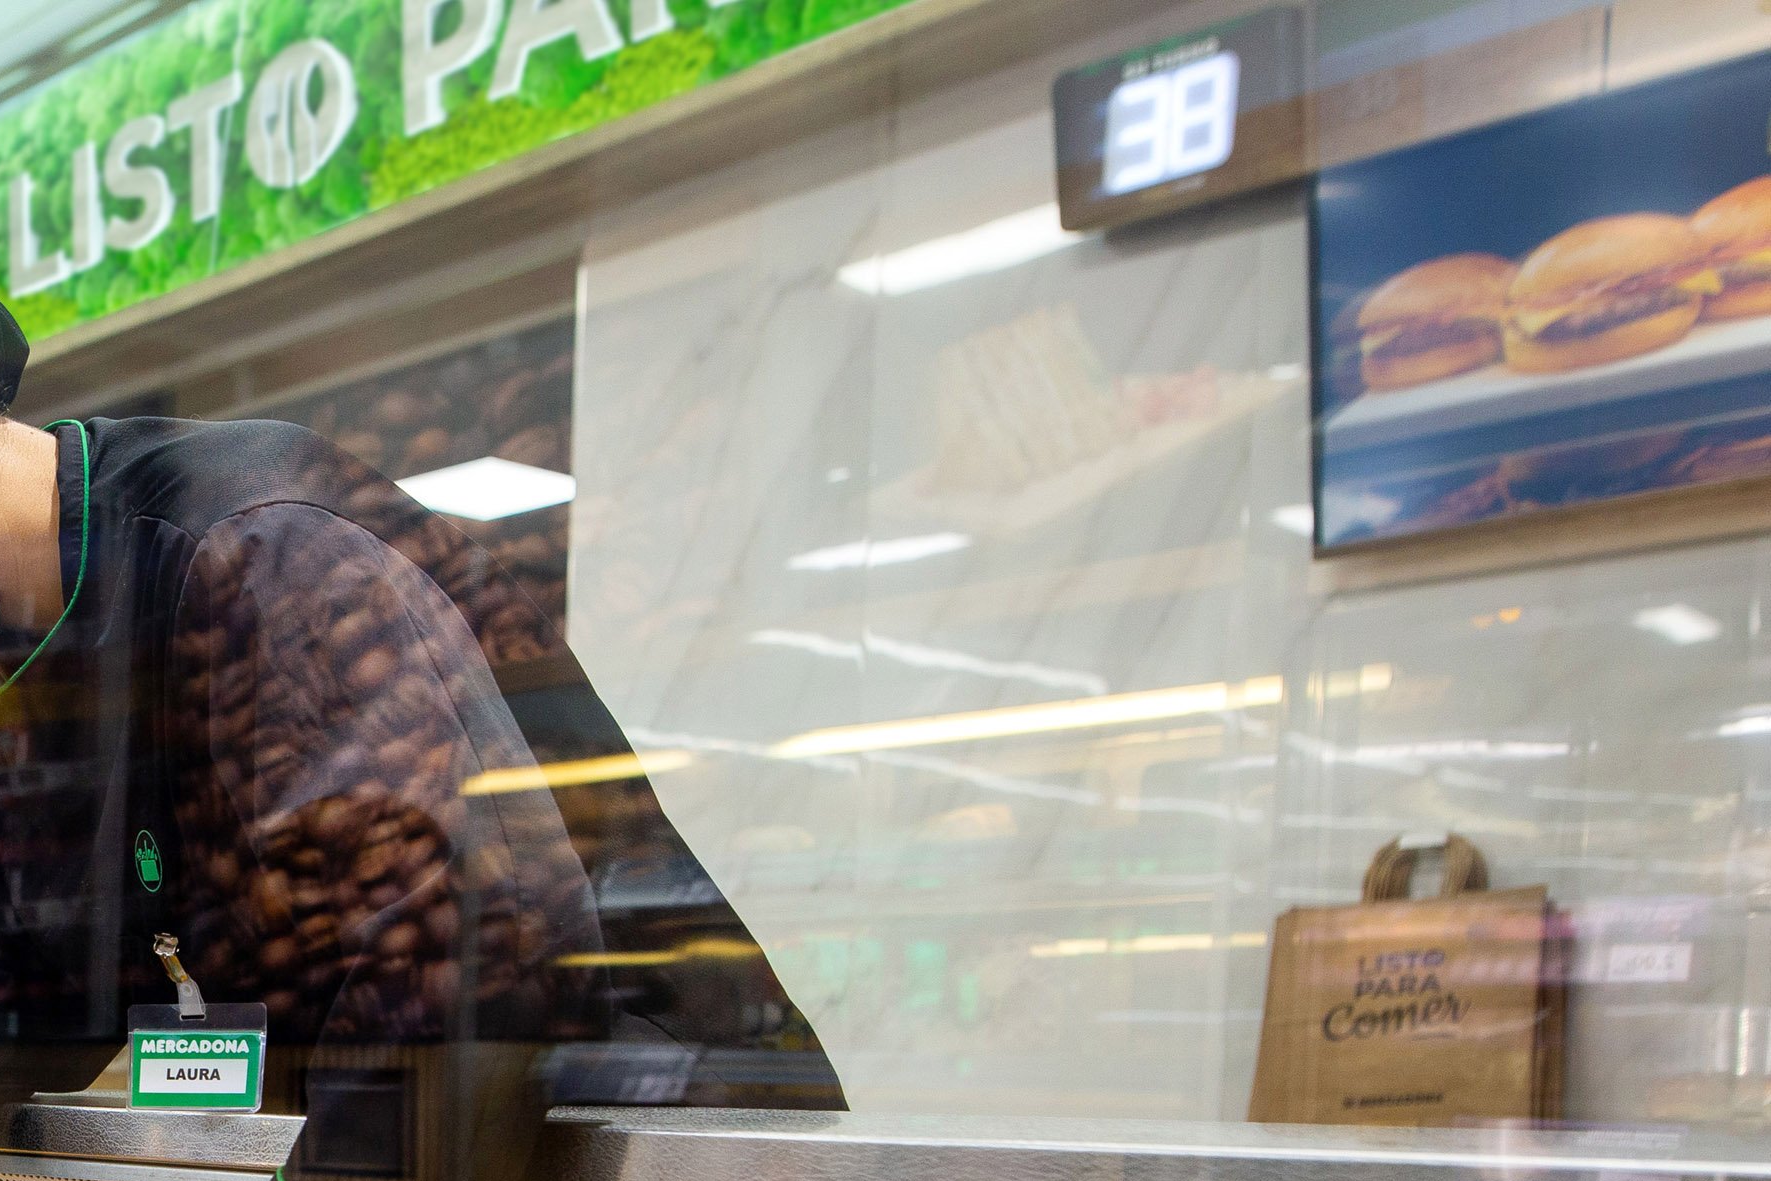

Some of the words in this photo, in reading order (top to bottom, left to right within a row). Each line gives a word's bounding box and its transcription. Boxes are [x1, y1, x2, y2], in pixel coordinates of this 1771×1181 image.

[1100, 53, 1240, 196] 38
[9, 37, 359, 298] LISTO
[1355, 949, 1445, 977] LISTO
[1353, 974, 1441, 1001] PARA
[1321, 992, 1472, 1042] Comer
[140, 1039, 250, 1054] MERCADONA
[166, 1068, 221, 1081] LAURA
